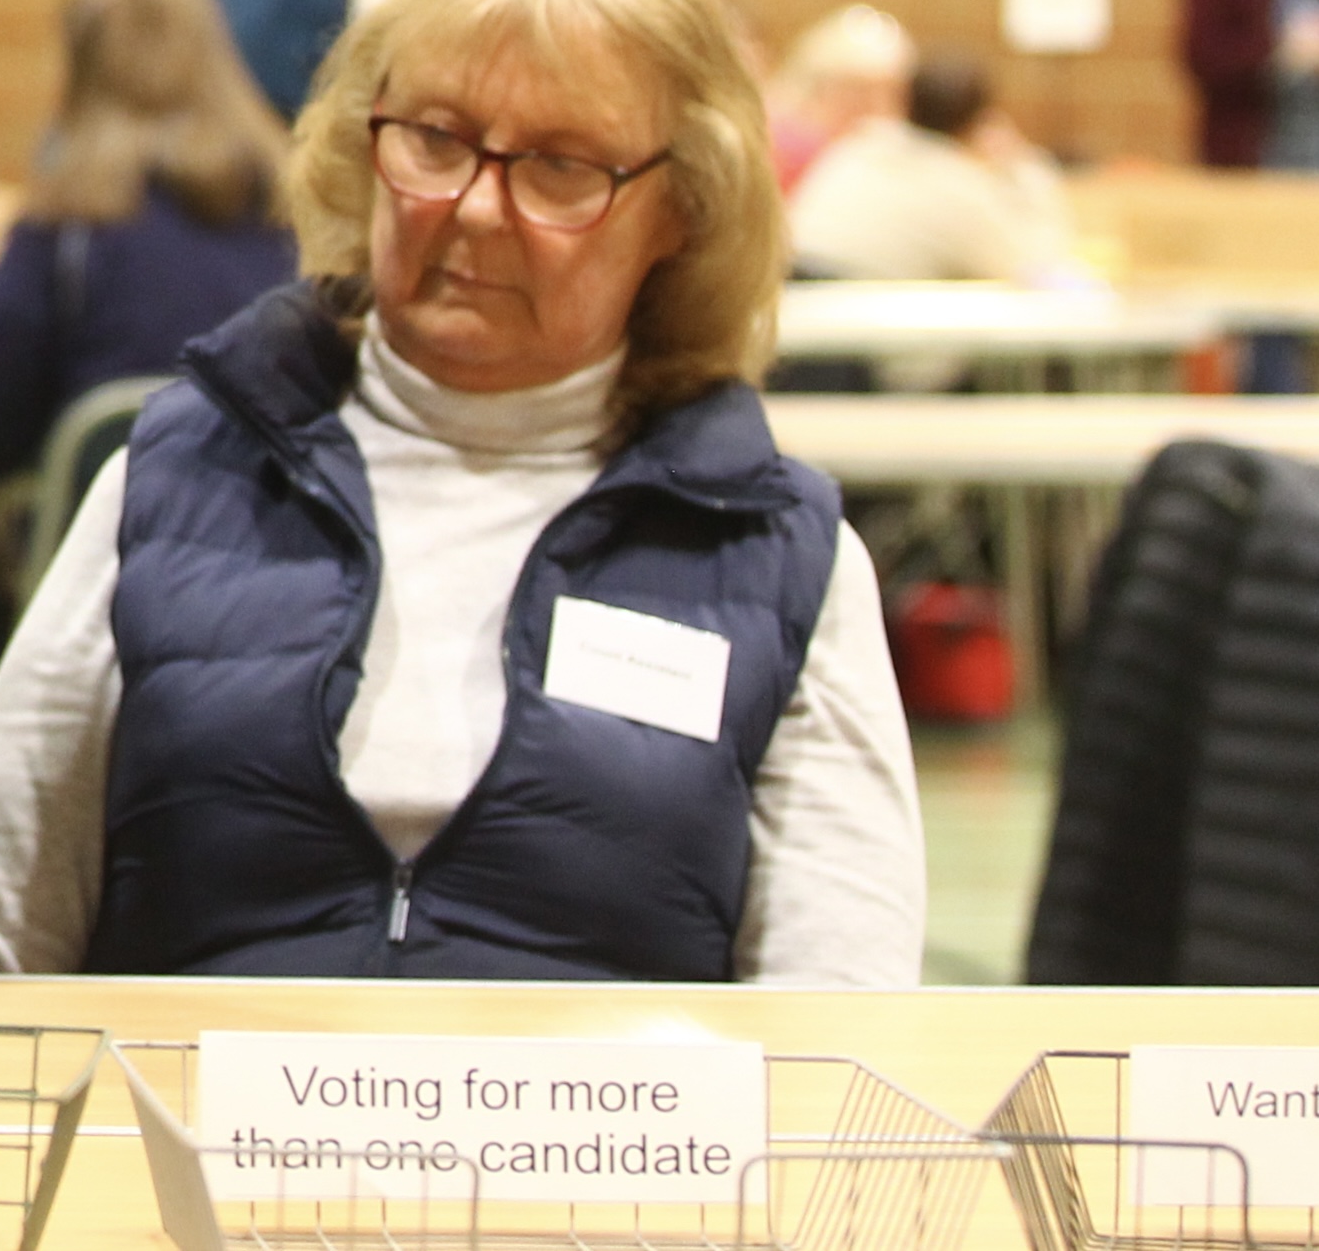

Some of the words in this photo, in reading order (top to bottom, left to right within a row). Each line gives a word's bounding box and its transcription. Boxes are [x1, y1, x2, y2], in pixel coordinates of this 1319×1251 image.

[281, 1065, 443, 1121] Voting
[463, 1068, 530, 1111] for
[549, 1080, 680, 1113] more
[231, 1127, 343, 1170] than
[364, 1138, 459, 1173] one
[479, 1134, 732, 1176] candidate
